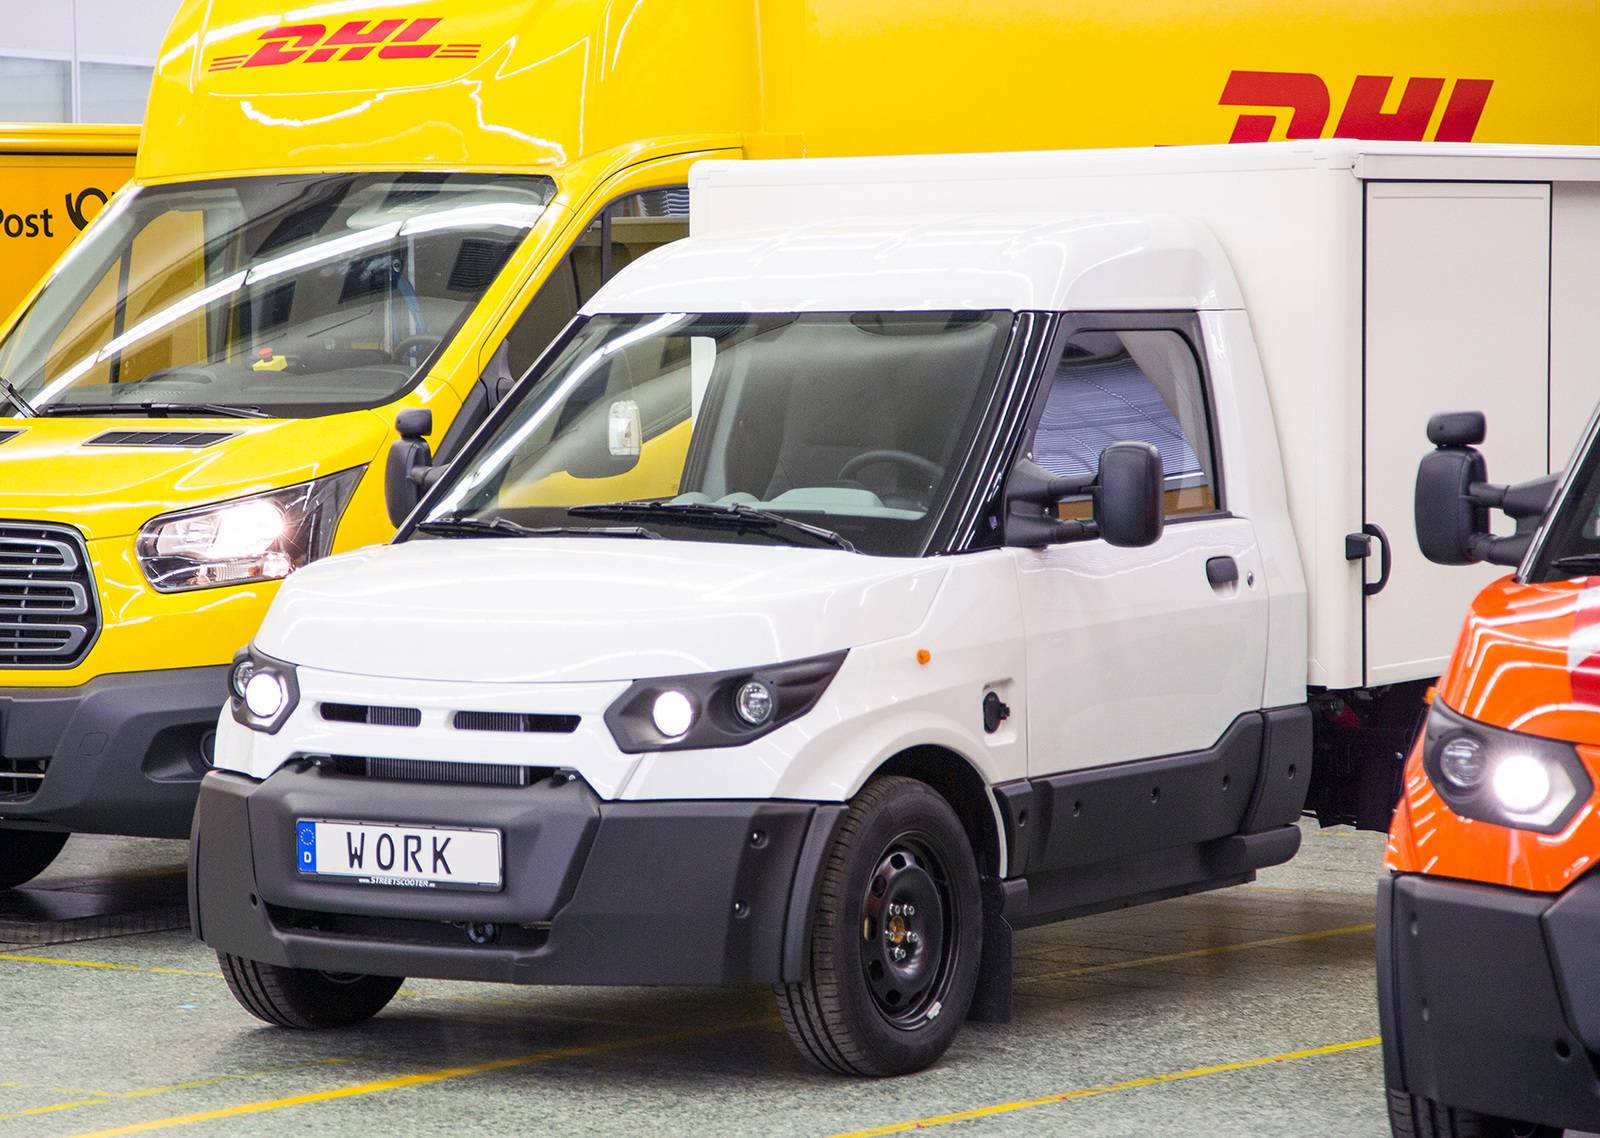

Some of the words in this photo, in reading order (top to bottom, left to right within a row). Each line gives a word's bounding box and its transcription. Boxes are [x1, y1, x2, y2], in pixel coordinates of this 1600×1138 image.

[241, 17, 444, 68] DHL
[0, 208, 54, 238] ost
[303, 851, 312, 863] D
[346, 831, 452, 875] WORK
